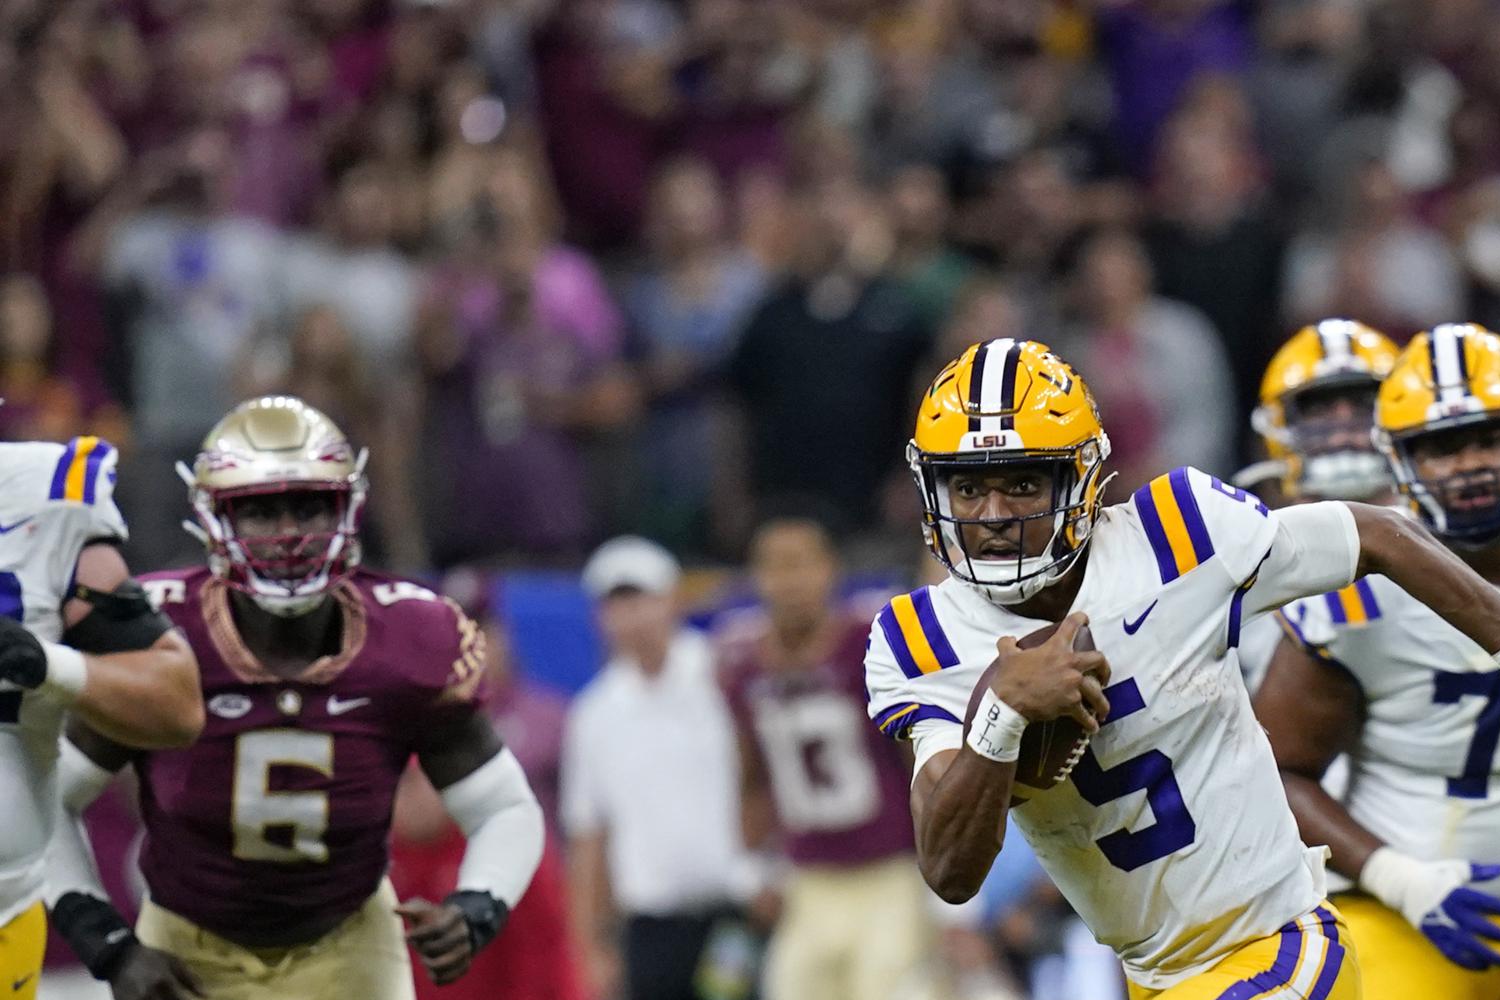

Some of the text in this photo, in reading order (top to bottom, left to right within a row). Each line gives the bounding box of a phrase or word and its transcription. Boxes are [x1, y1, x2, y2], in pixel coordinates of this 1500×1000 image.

[973, 435, 1007, 448] LSU
[233, 728, 334, 863] 6
[1070, 676, 1196, 872] 5
